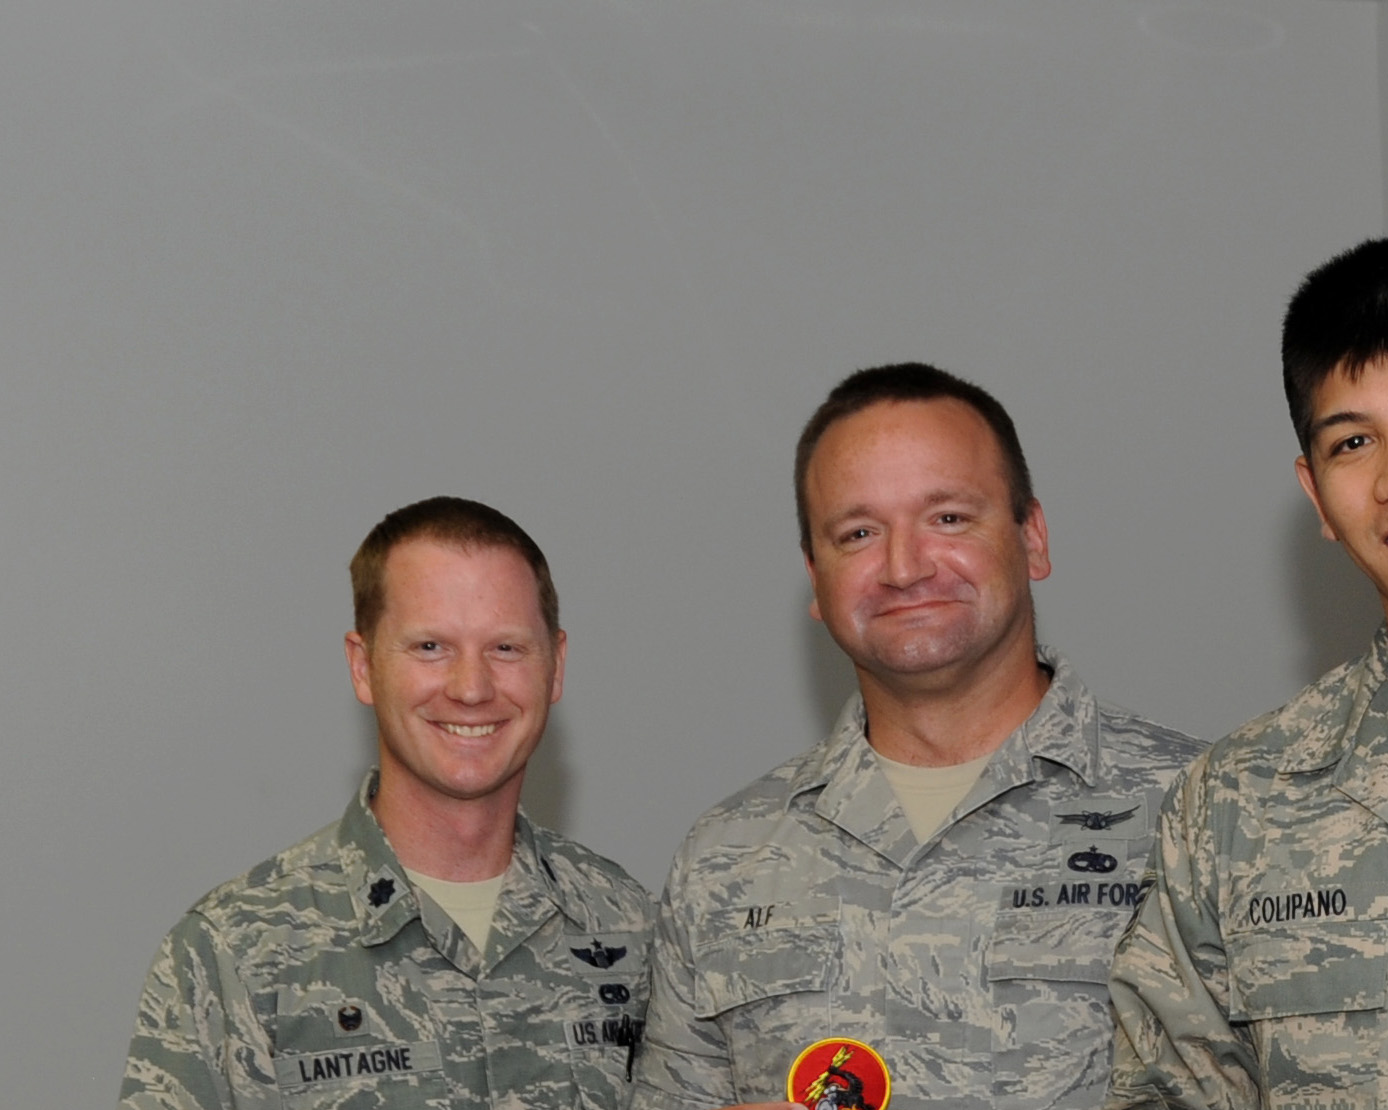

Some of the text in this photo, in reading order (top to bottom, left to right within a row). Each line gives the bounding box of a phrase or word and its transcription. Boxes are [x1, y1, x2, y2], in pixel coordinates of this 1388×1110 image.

[1013, 882, 1140, 909] U.S. AIR FOR
[1249, 888, 1347, 926] COLIPANO
[743, 904, 775, 929] ALF
[298, 1047, 413, 1083] LANTAGNE
